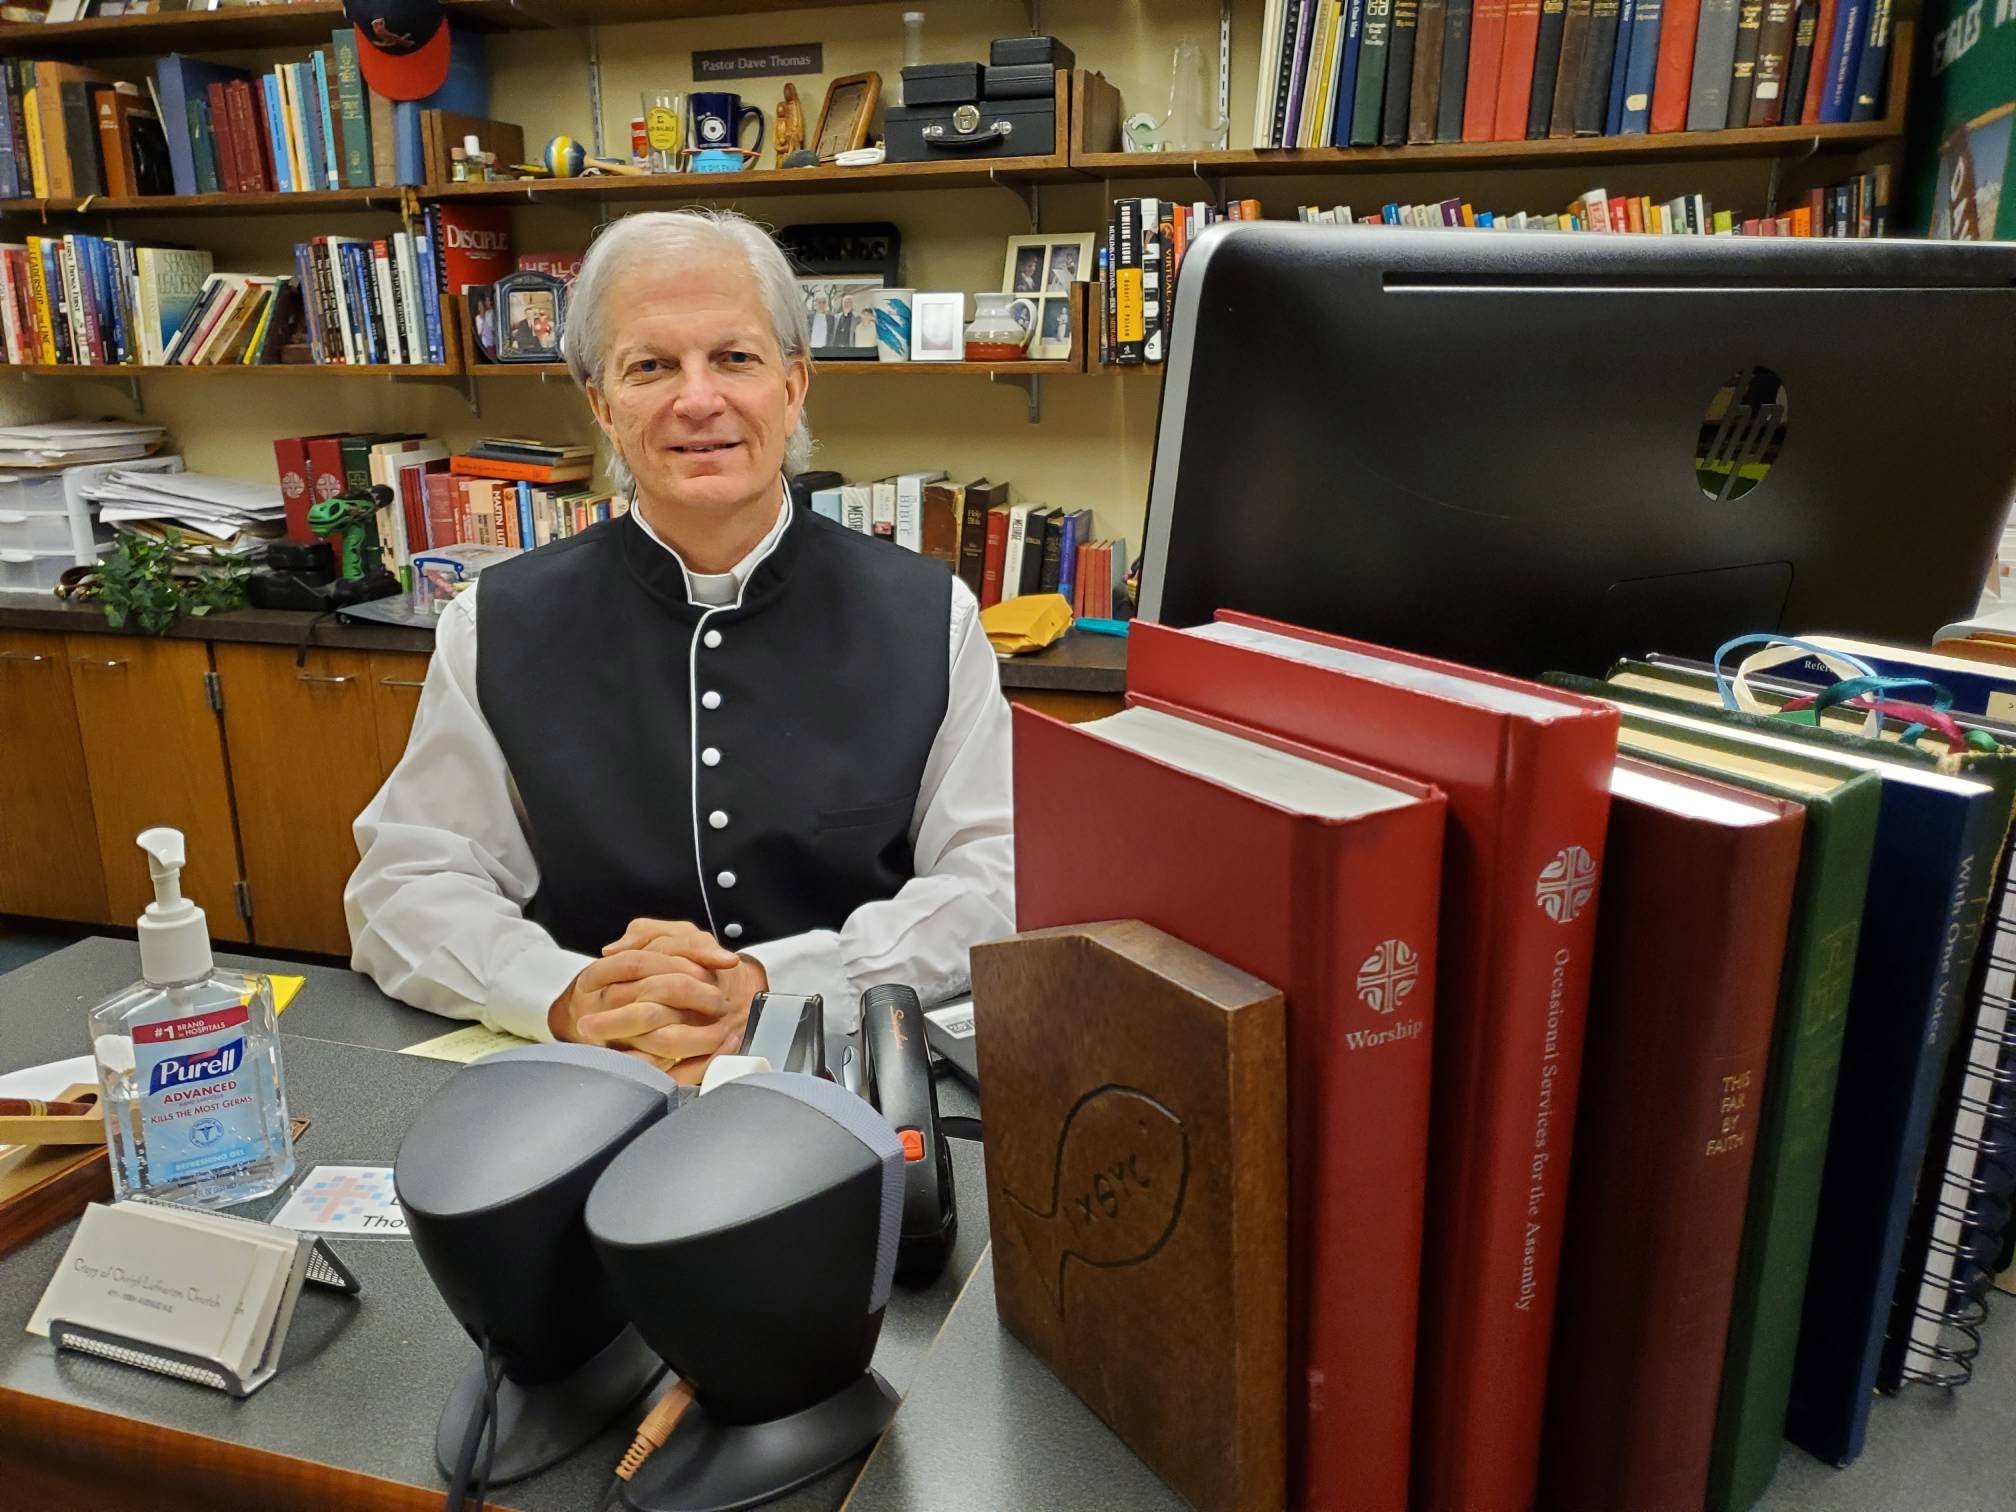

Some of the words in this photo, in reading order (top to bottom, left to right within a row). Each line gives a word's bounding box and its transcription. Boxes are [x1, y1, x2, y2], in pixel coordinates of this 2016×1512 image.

[702, 60, 735, 71] Pastor
[738, 57, 766, 69] Dave
[770, 55, 811, 67] Thomas
[446, 224, 508, 250] DISCIPLE
[1121, 206, 1131, 240] BOWLING
[1122, 242, 1131, 264] ALONE
[29, 250, 43, 304] LEADERSHIP
[1165, 248, 1173, 296] VIRTUAL
[492, 490, 503, 525] MARTIN
[899, 495, 914, 536] BIBLE
[1952, 855, 1974, 916] With
[1942, 923, 1960, 973] One
[1544, 948, 1570, 1061] Occasional
[1928, 981, 1949, 1044] Voice
[154, 1025, 174, 1039] #1
[177, 1020, 205, 1031] BRAND
[185, 1022, 226, 1037] HOSPITALS
[1344, 1018, 1424, 1051] Worship
[160, 1048, 235, 1085] Purell
[1722, 1070, 1752, 1092] THIS
[164, 1080, 237, 1104] ADVANCED
[1536, 1064, 1557, 1149] Services
[1721, 1093, 1745, 1113] FAR
[151, 1111, 174, 1124] KILLS
[176, 1109, 192, 1119] THE
[194, 1103, 219, 1115] MOST
[222, 1095, 253, 1109] GERMS
[1722, 1114, 1739, 1133] BY
[1706, 1133, 1745, 1156] FAITH
[1531, 1152, 1550, 1182] for
[1528, 1185, 1545, 1215] the
[362, 1215, 408, 1228] Tho
[1514, 1221, 1541, 1312] Assembly
